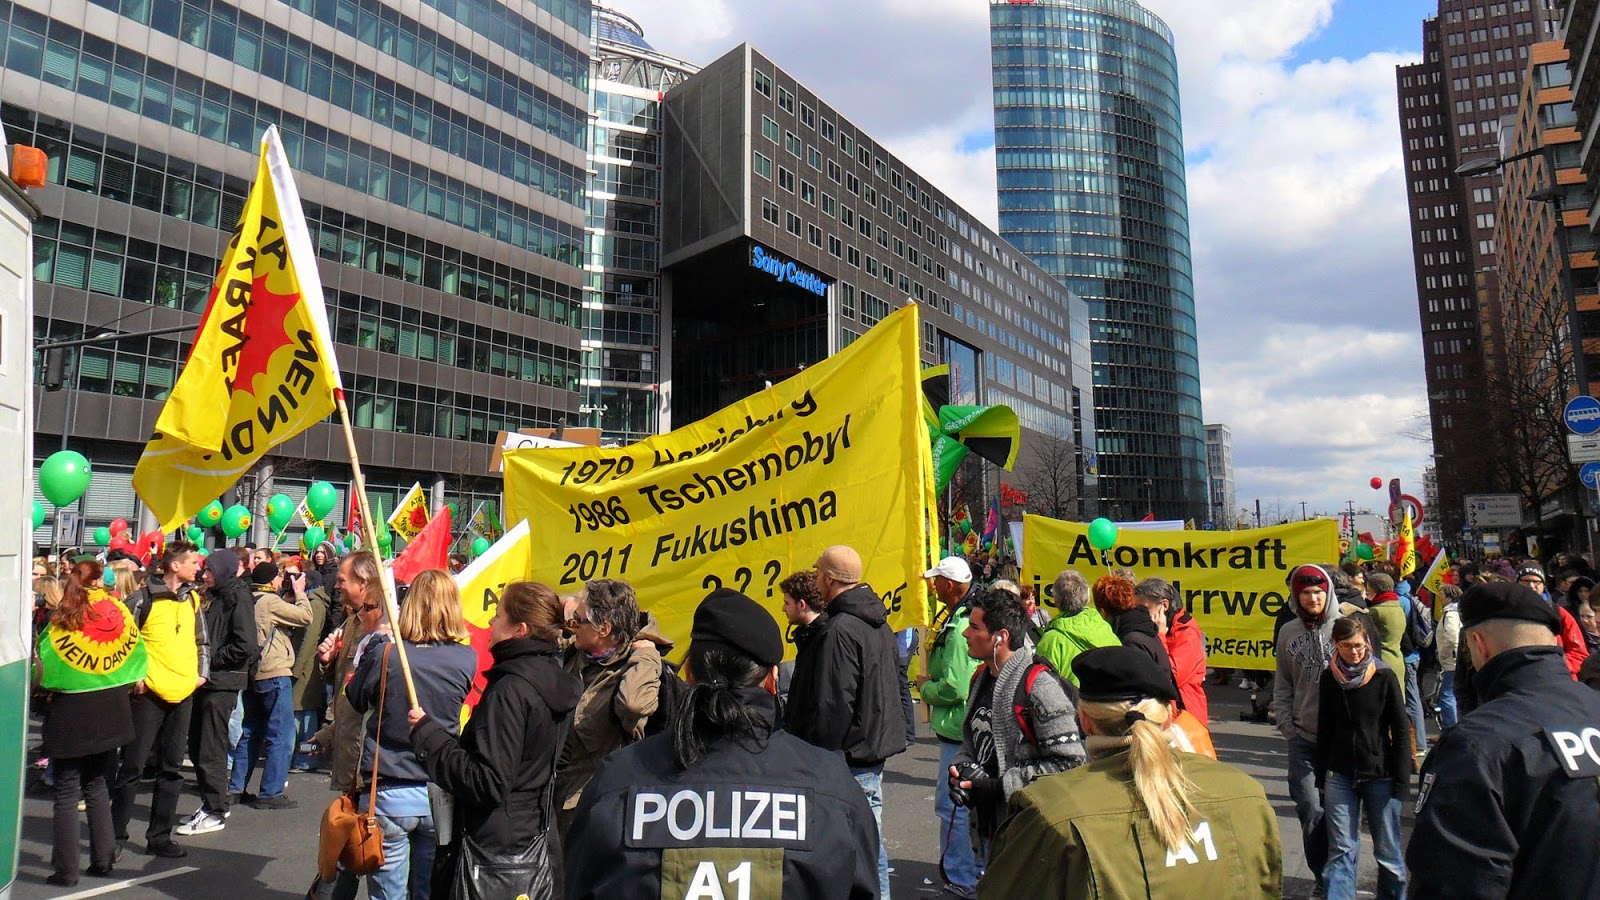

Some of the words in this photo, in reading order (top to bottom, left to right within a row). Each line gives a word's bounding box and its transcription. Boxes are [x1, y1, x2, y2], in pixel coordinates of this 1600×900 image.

[752, 245, 786, 283] Sony
[786, 261, 828, 297] Center
[560, 455, 634, 486] 1979
[568, 495, 631, 533] 1986
[638, 413, 852, 516] Tschernobyl
[559, 543, 633, 585] 2011
[651, 490, 838, 568] Fukushima
[1173, 580, 1286, 617] rrwe
[55, 634, 100, 671] NEIN
[103, 626, 139, 671] DANKE
[632, 789, 806, 841] POLIZEI
[1165, 821, 1219, 867] A1
[684, 861, 753, 900] A1
